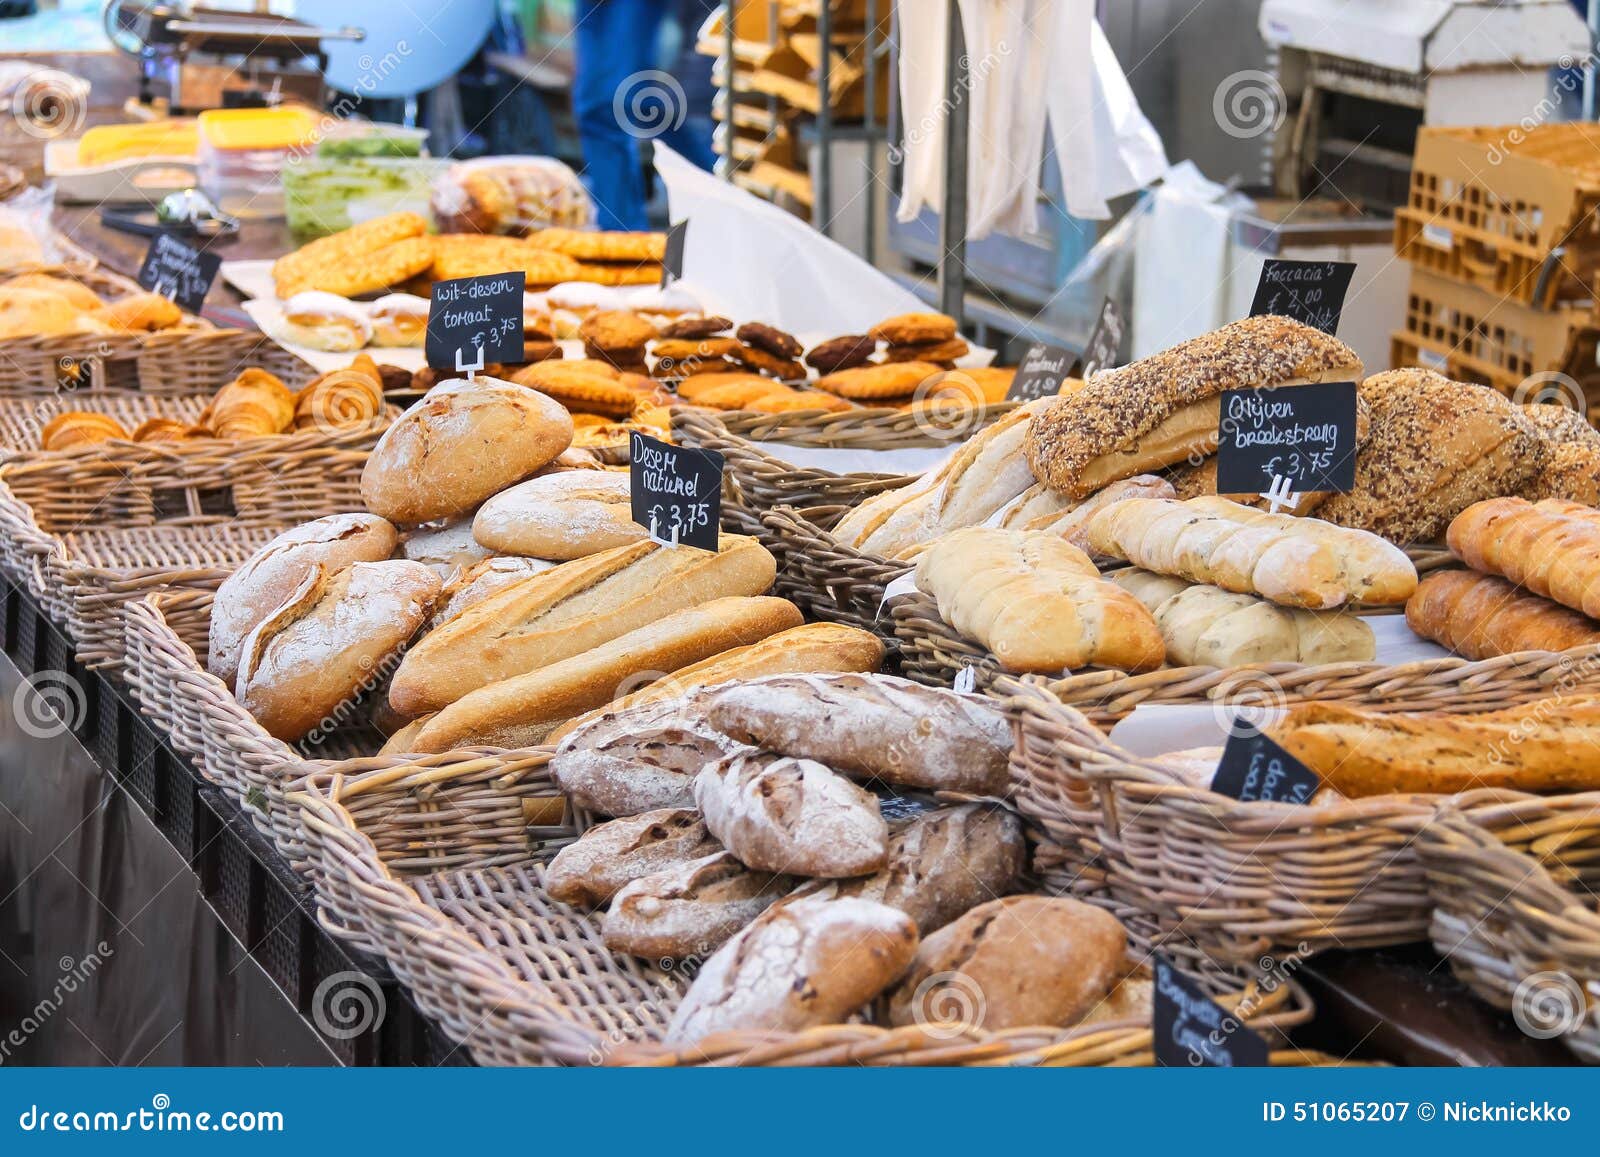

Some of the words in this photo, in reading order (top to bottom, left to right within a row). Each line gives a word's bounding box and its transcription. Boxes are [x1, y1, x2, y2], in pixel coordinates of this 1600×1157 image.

[490, 317, 518, 348] 3,75
[1286, 452, 1334, 480] 3,75
[667, 503, 710, 537] 3,75
